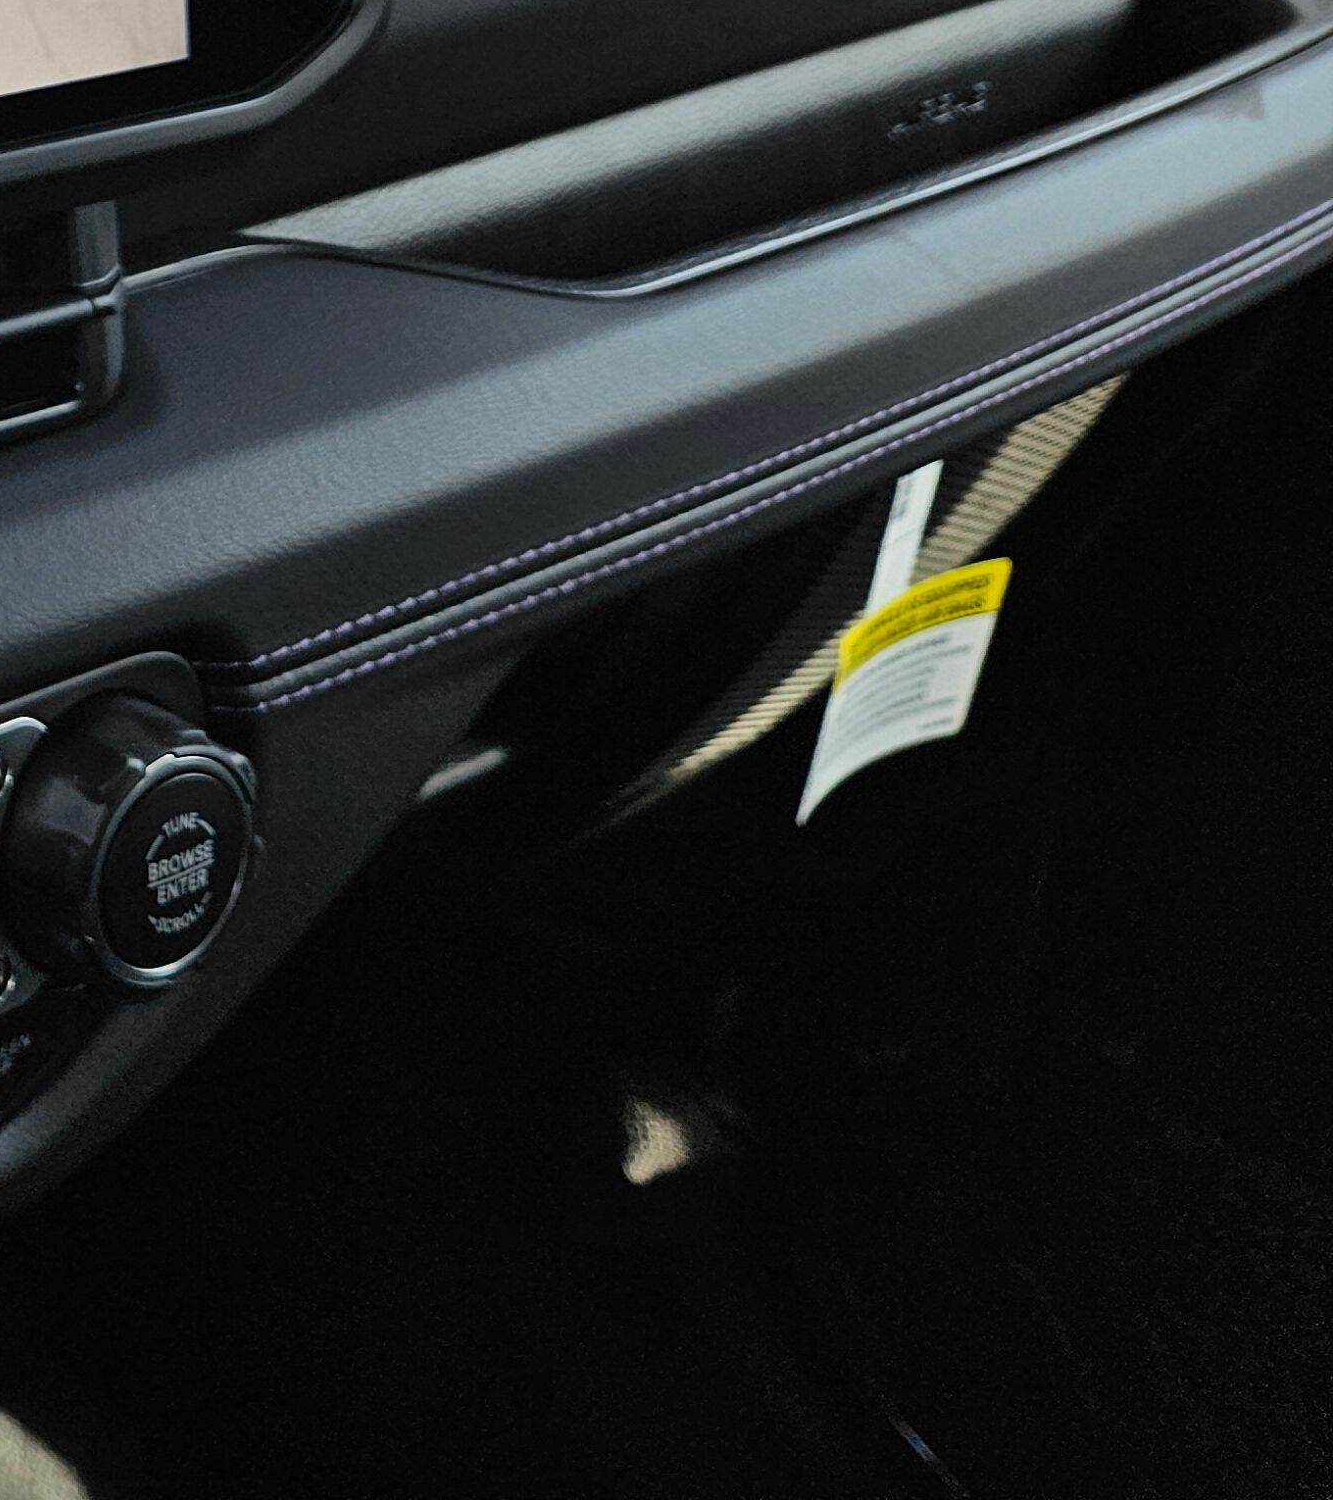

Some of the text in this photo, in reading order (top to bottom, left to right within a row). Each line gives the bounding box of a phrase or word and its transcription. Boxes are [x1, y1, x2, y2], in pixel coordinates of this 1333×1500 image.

[161, 811, 200, 839] TUNE
[147, 838, 215, 882] BROWSE
[156, 868, 210, 906] ENTER
